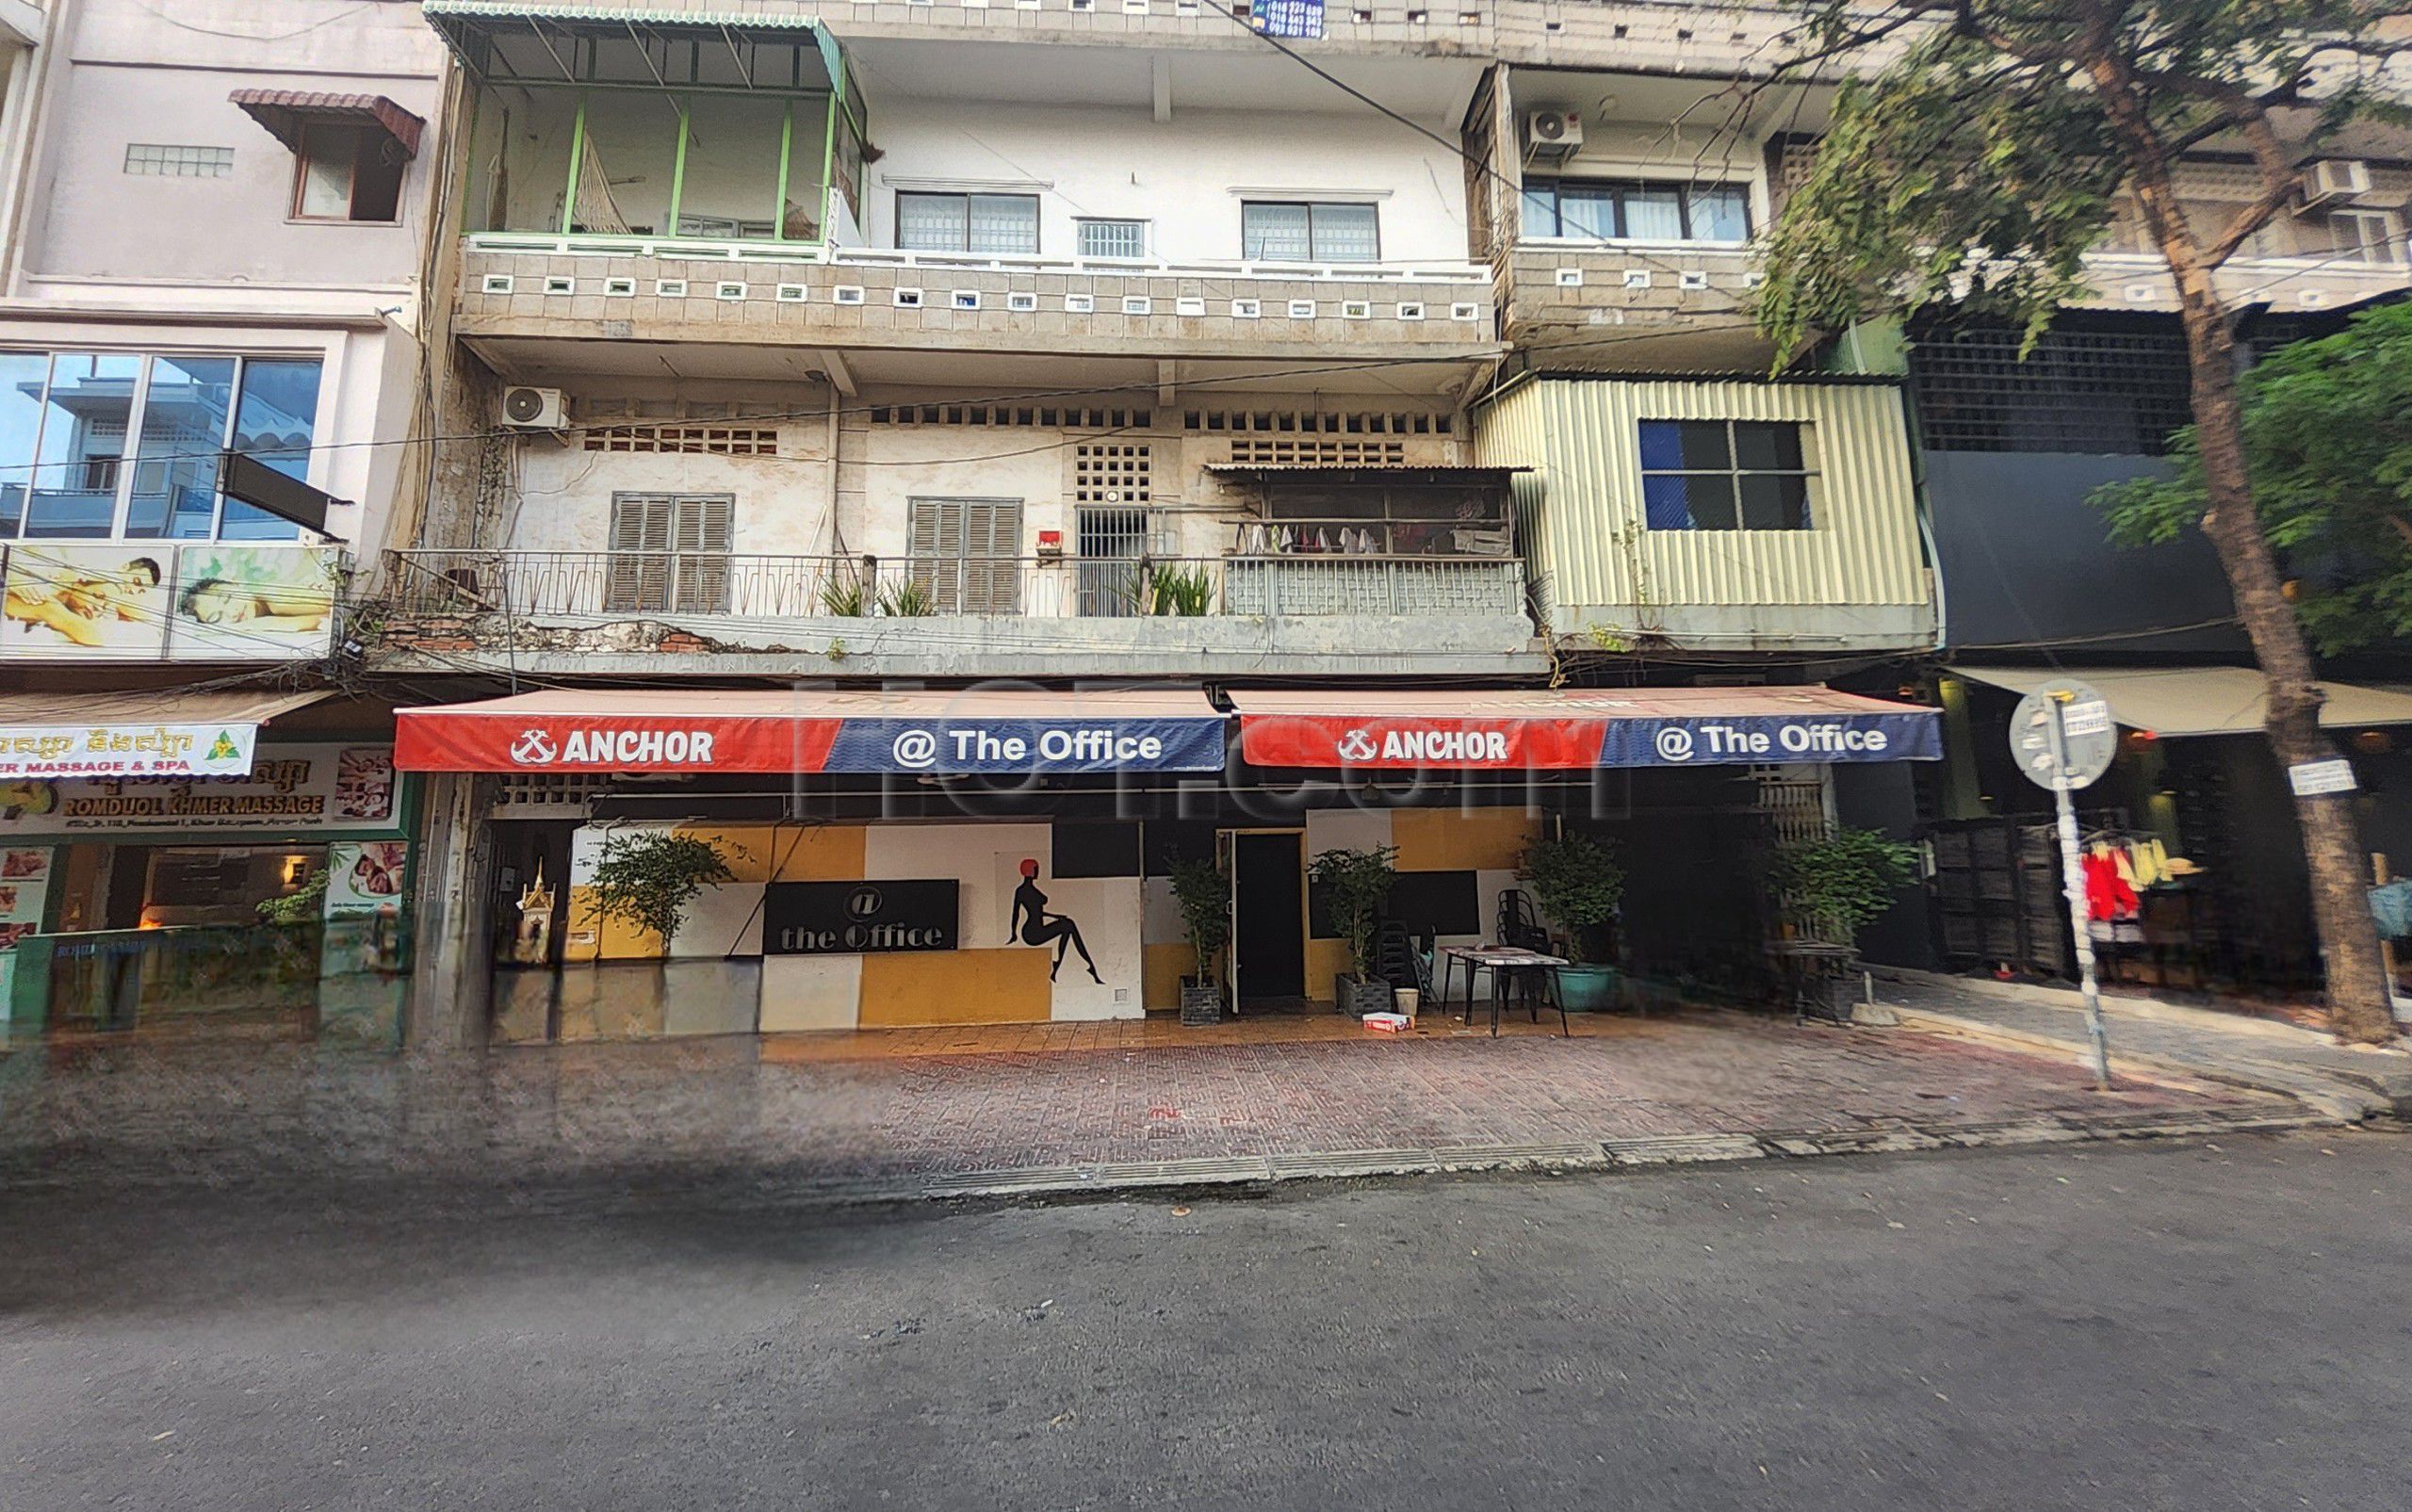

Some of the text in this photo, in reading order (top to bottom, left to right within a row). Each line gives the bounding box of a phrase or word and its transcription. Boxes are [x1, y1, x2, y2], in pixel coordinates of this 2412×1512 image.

[562, 729, 713, 764] ANCHOR
[892, 728, 1162, 769] @ The Office
[1381, 729, 1508, 761] ANCHOR
[1655, 724, 1888, 761] @ The Office
[24, 761, 124, 773] MASSAGE
[130, 761, 145, 772] &
[152, 760, 190, 772] SPA
[63, 795, 325, 817] ROMDUOL KHMER MASSAGE
[781, 921, 942, 950] the Office
